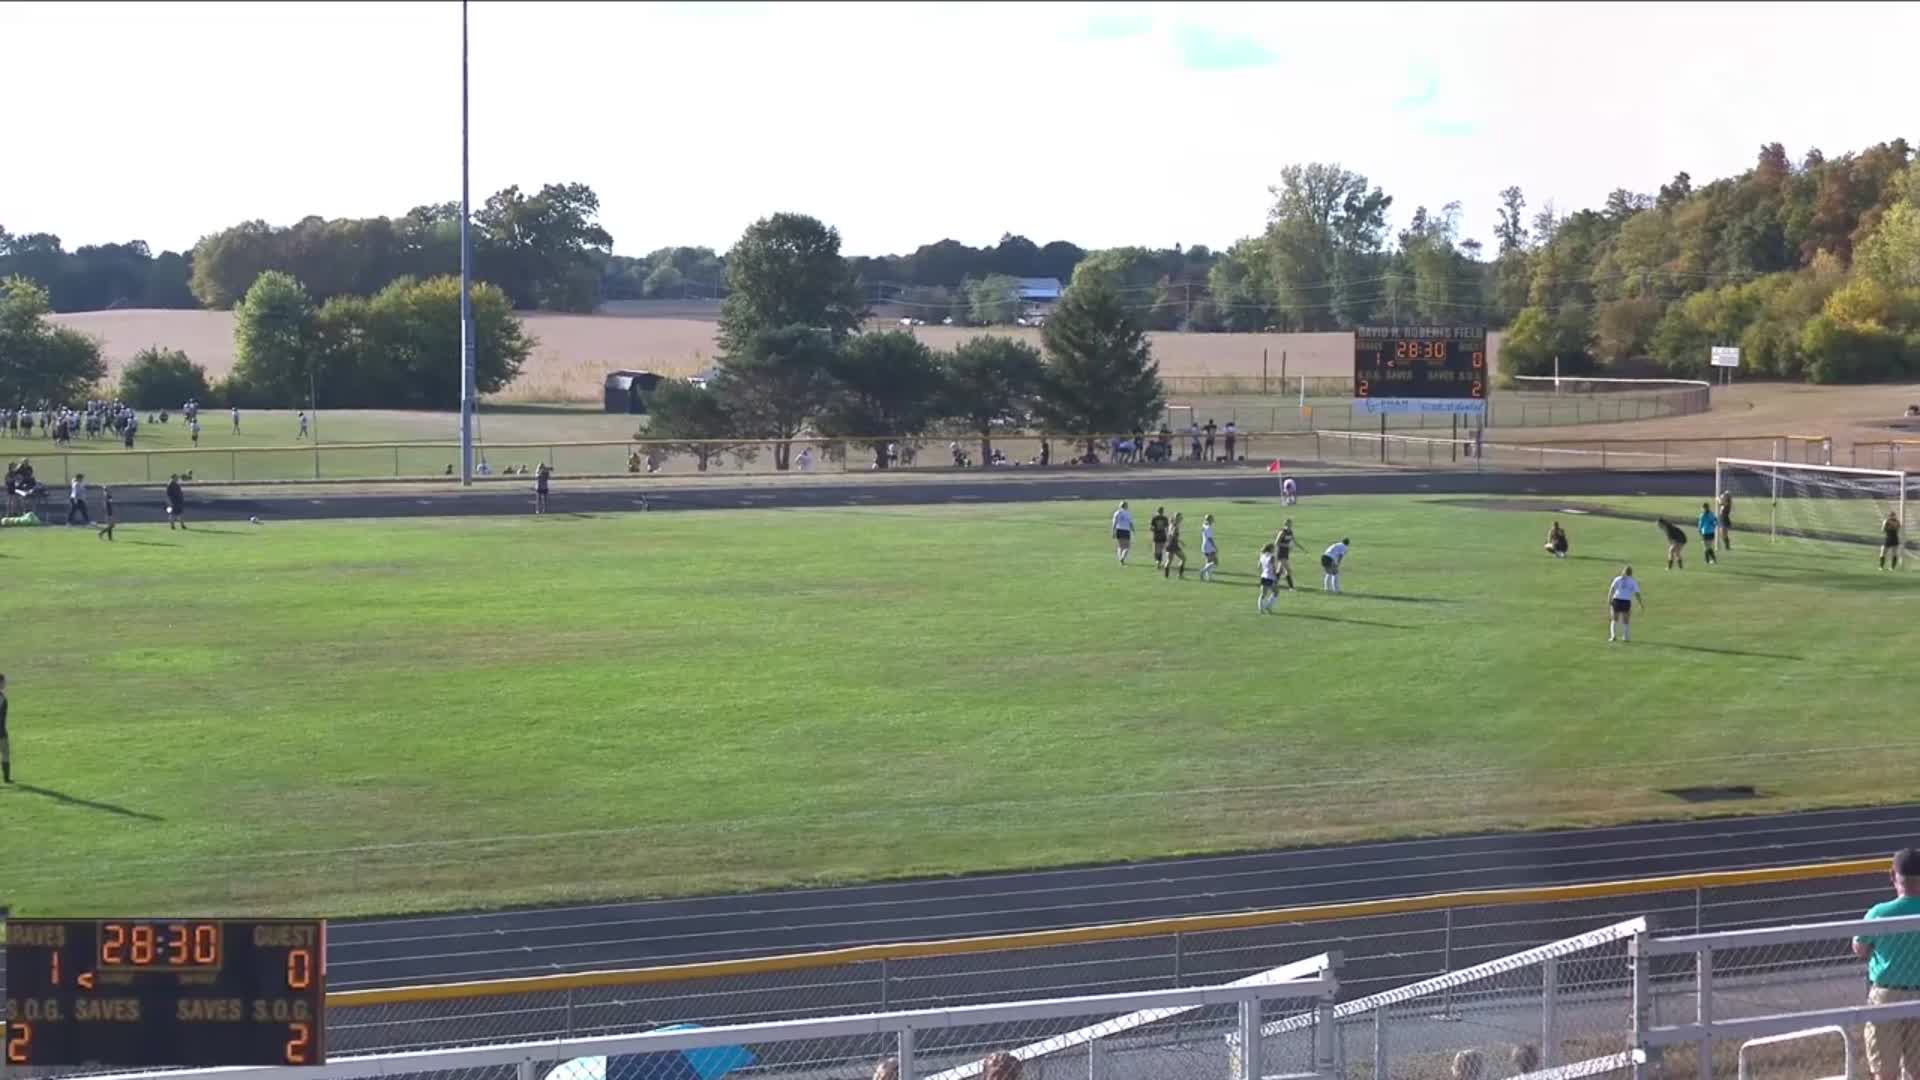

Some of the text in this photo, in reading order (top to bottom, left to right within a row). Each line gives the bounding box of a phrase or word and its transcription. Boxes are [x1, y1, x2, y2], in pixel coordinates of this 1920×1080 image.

[1396, 341, 1445, 358] 28:30
[1471, 351, 1483, 368] 0
[1359, 380, 1369, 396] 2
[1471, 380, 1482, 397] 2
